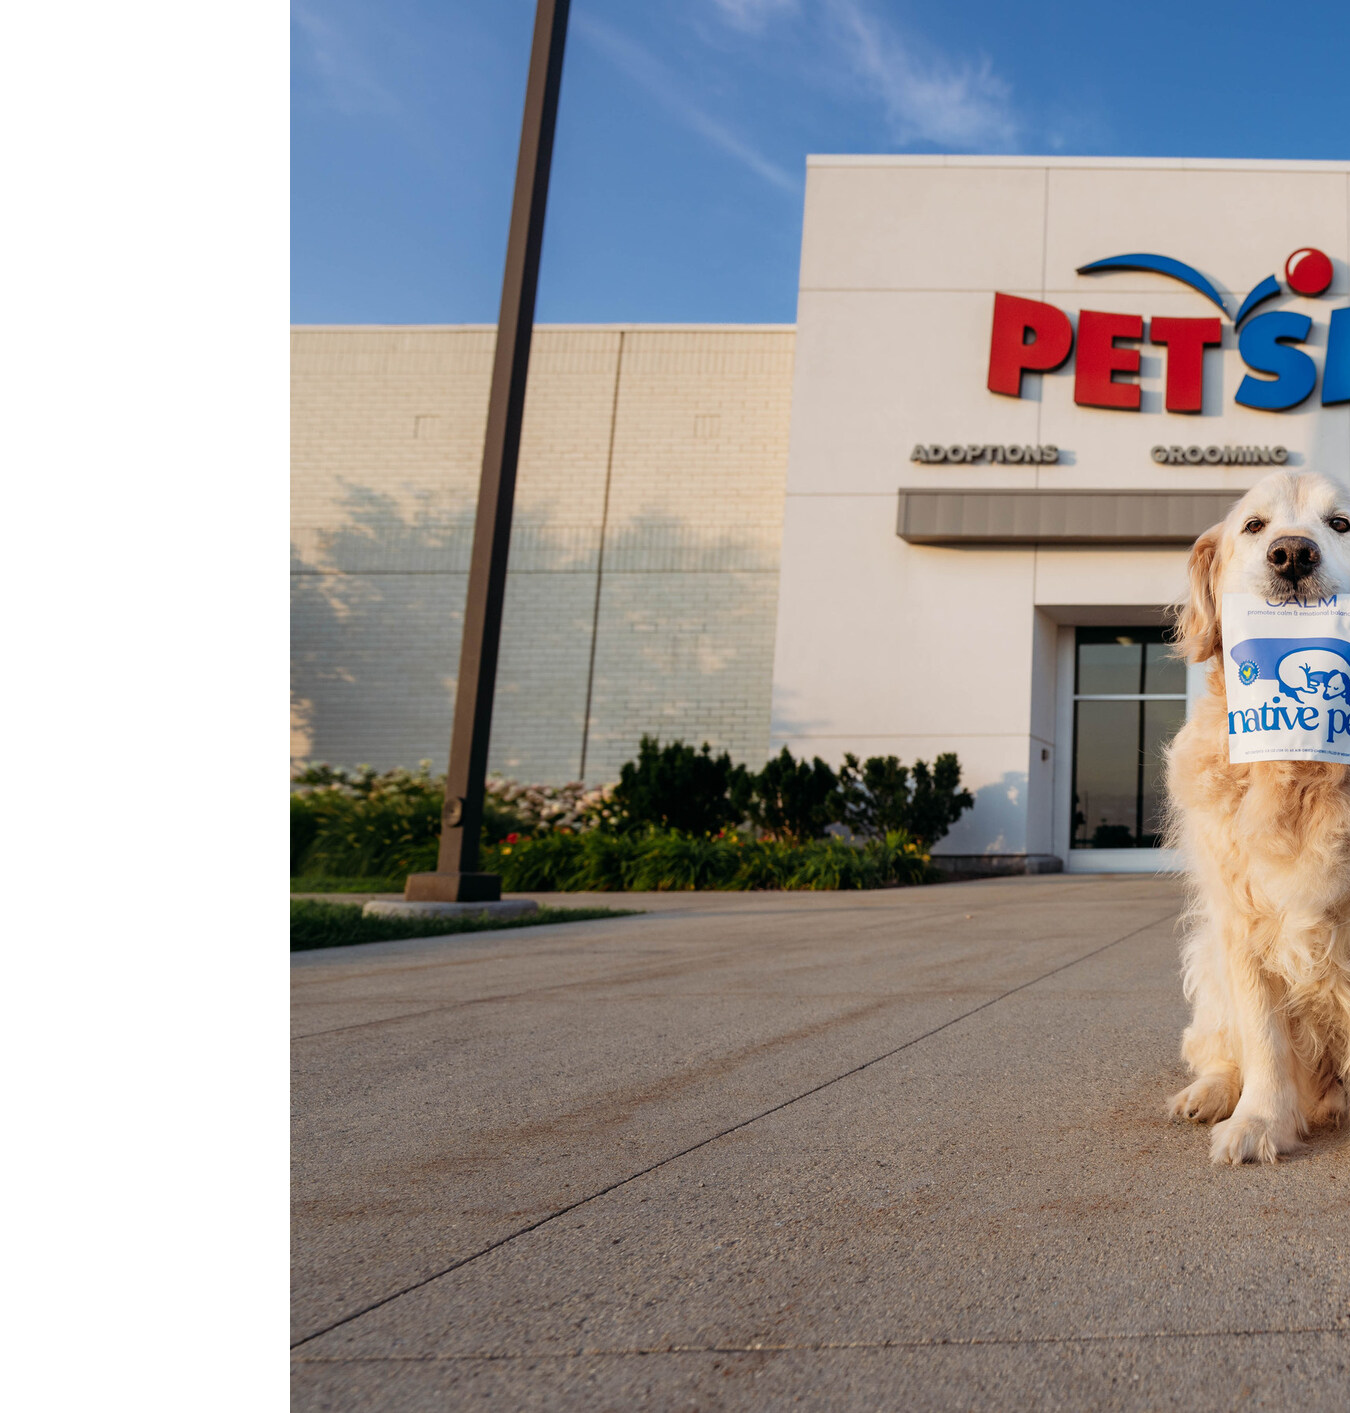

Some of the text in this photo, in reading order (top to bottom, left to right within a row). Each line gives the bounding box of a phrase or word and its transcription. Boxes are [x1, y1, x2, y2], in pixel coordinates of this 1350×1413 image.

[911, 444, 1060, 465] ADOPTIONS
[1151, 444, 1289, 466] GROOMING
[1228, 696, 1319, 735] native
